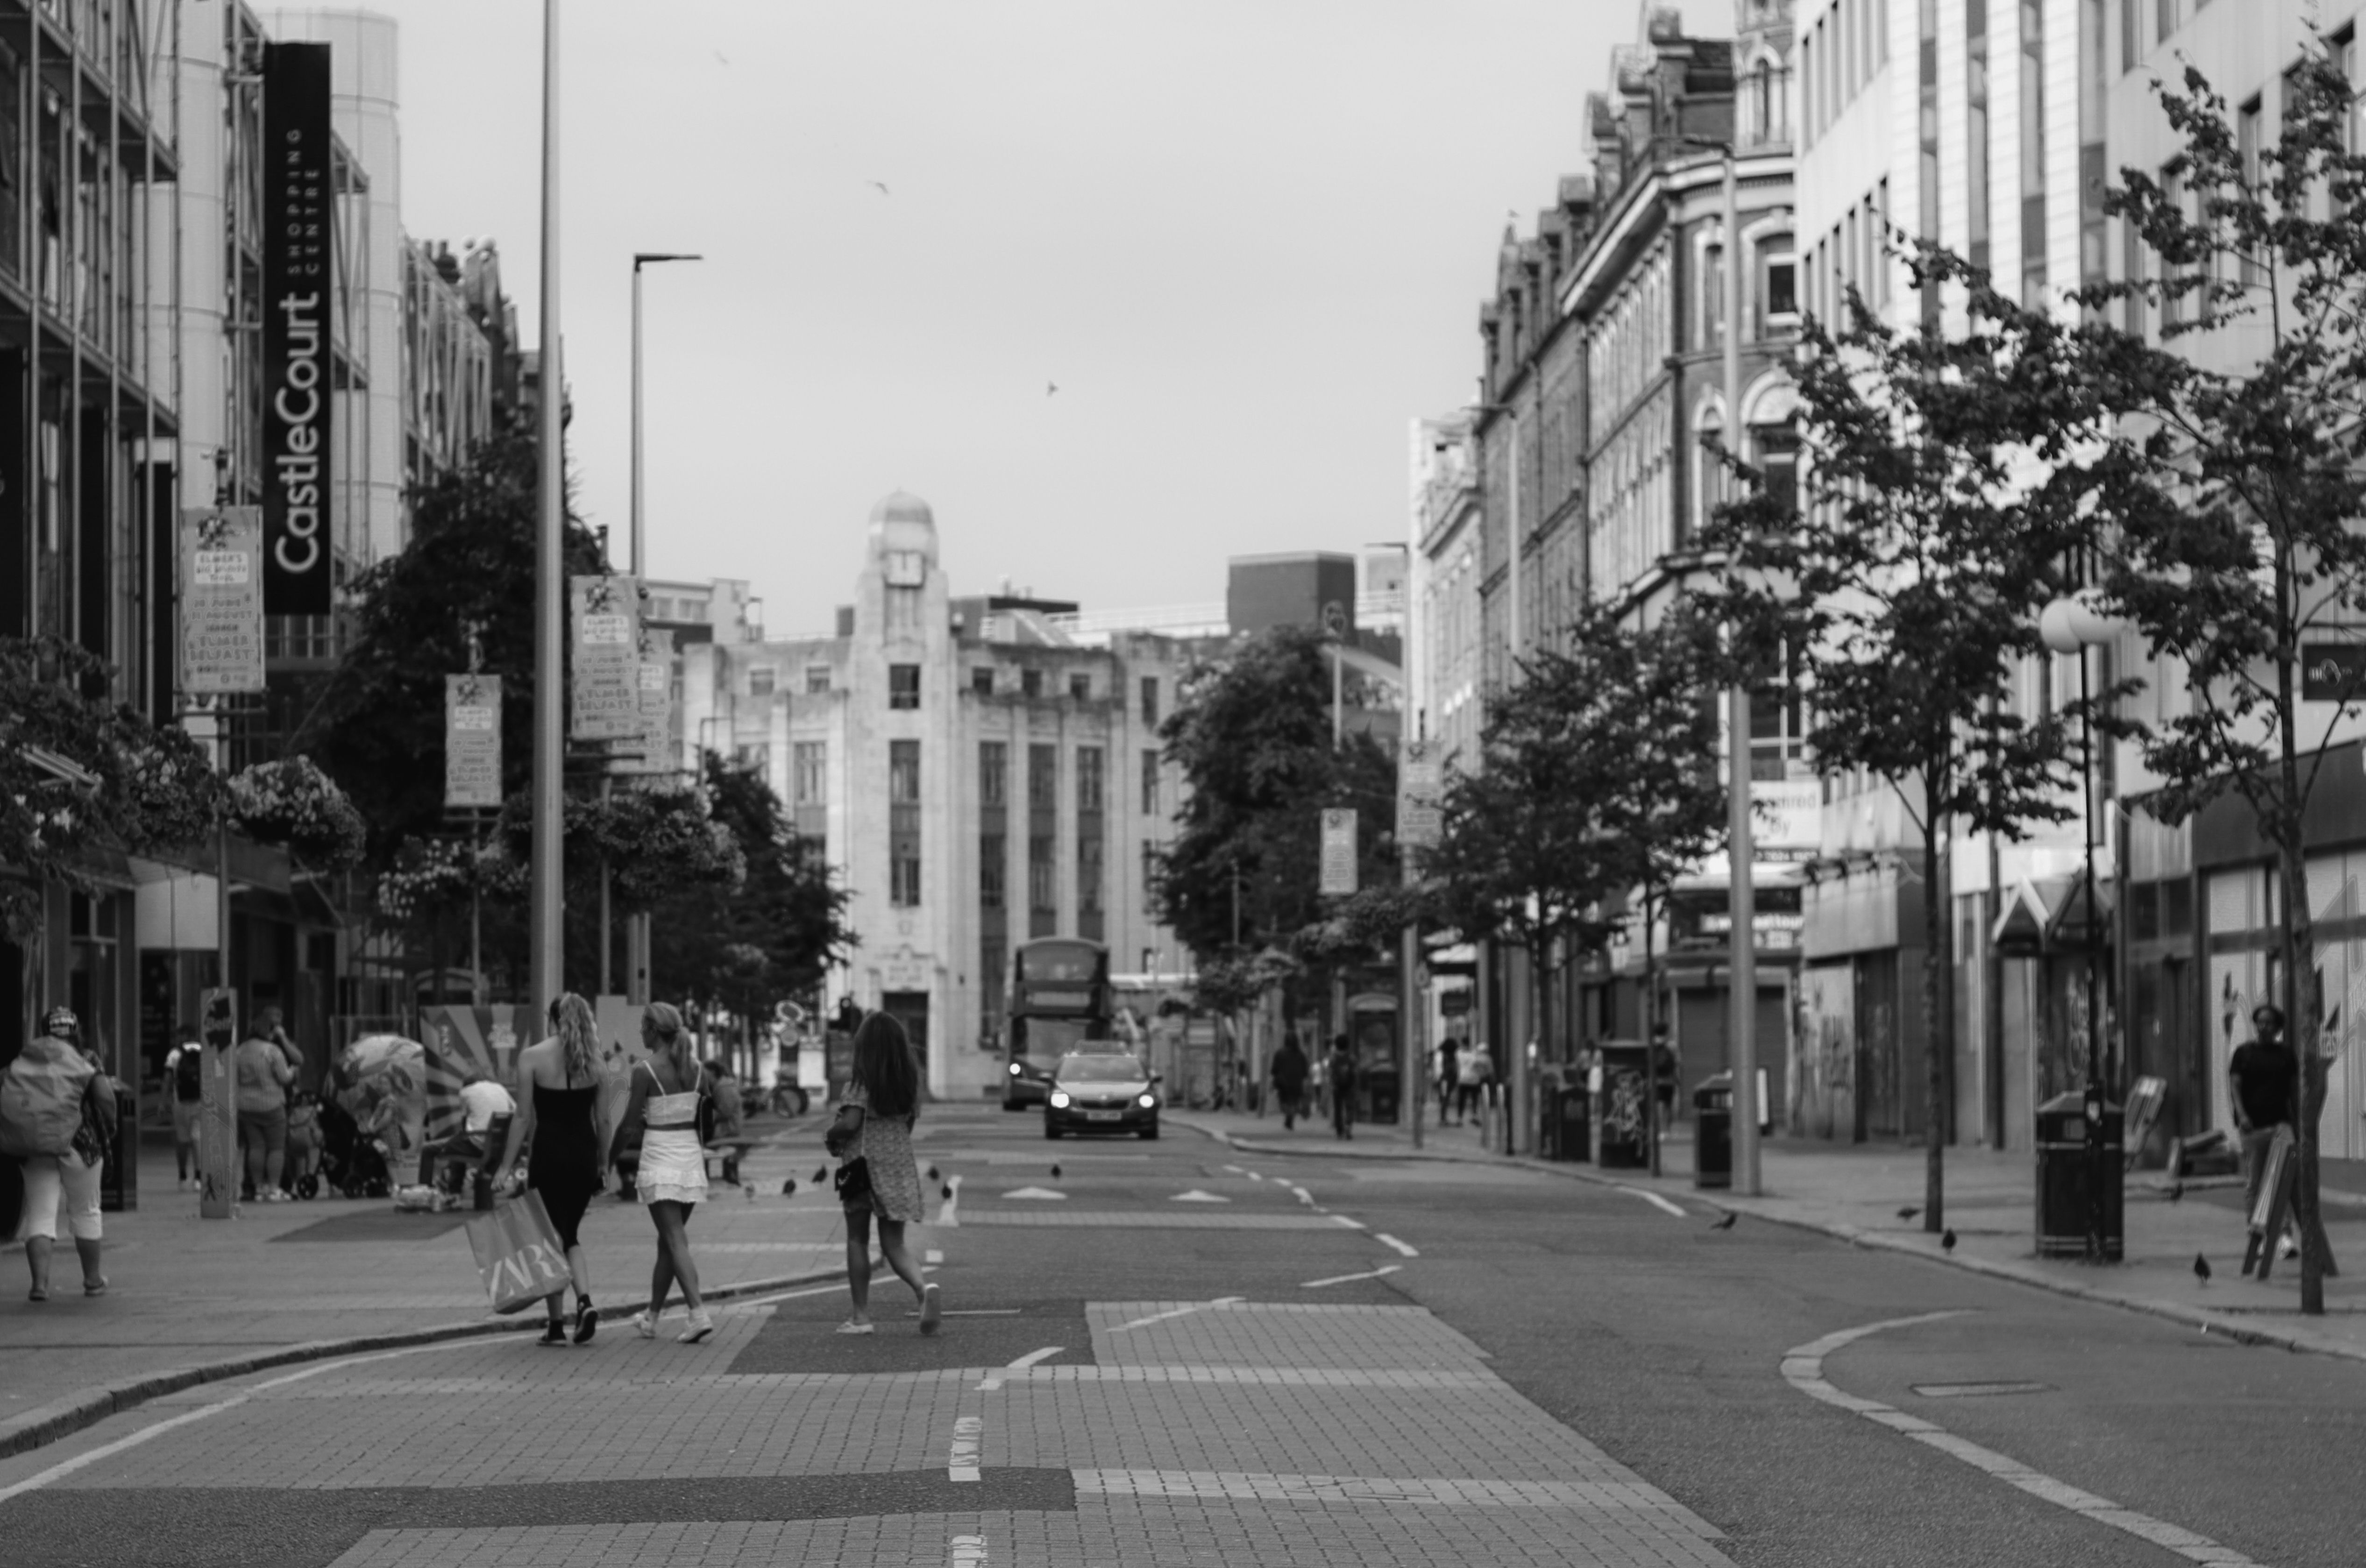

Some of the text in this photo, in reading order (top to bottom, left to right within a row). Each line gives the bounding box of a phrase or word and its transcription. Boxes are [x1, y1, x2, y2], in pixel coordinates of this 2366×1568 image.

[286, 128, 301, 275] SHOPPING
[305, 168, 319, 275] CENTRE
[275, 291, 319, 573] CastleCourt
